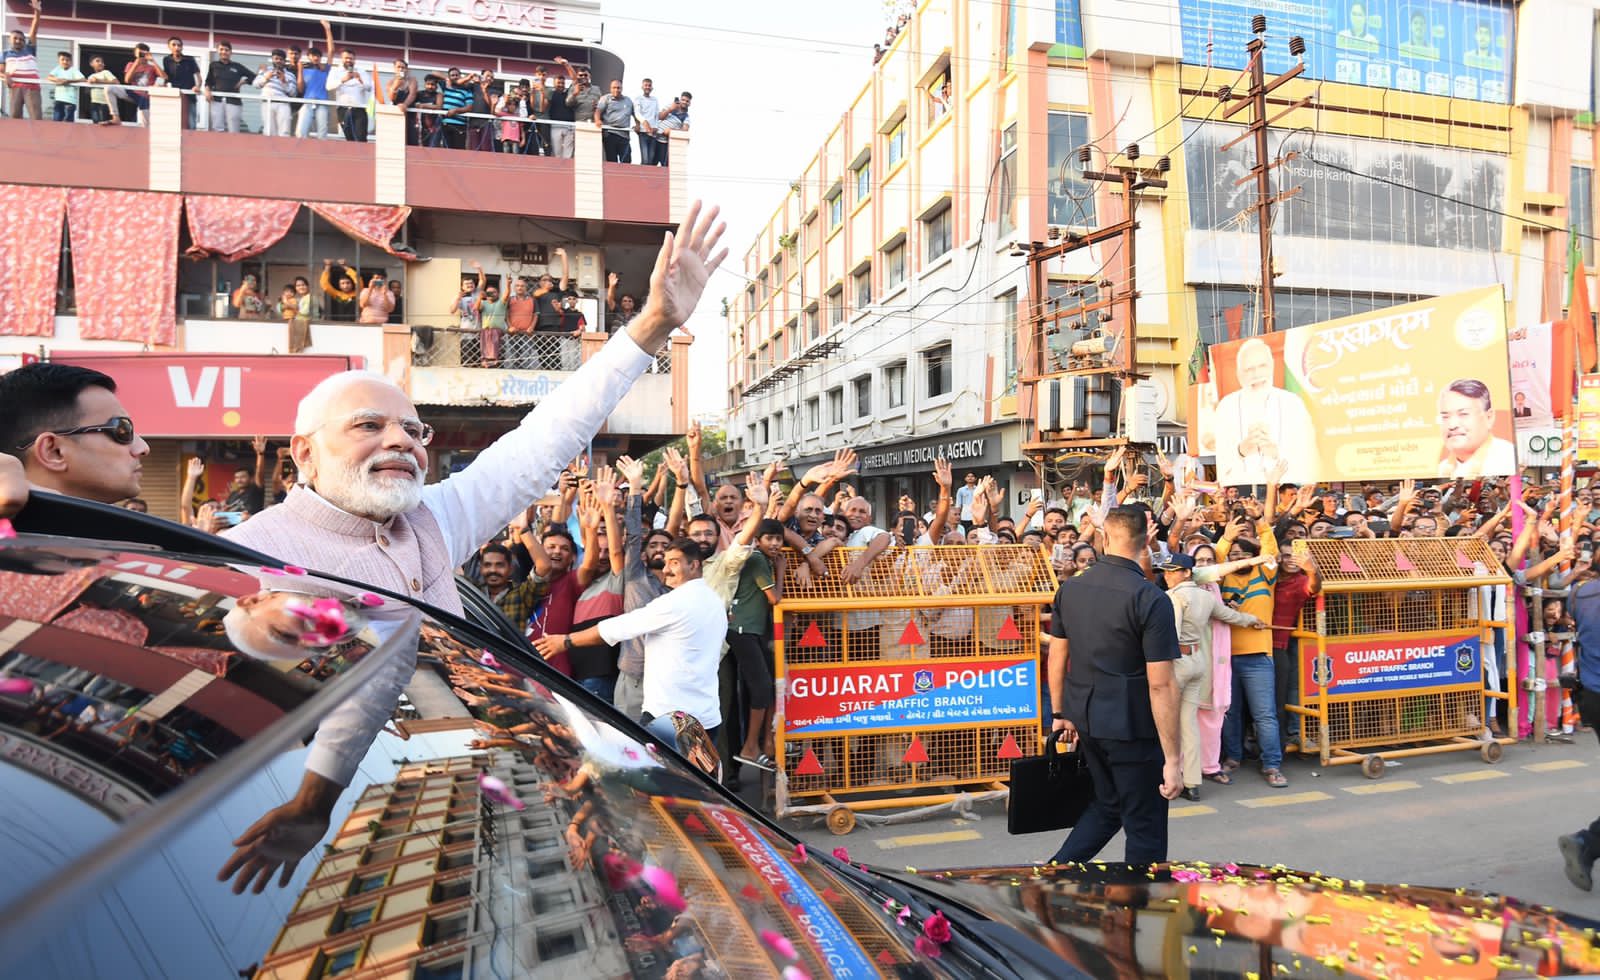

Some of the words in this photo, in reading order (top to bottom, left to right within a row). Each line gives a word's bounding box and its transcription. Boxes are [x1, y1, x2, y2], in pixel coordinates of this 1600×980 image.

[307, 0, 440, 16] ERY
[471, 0, 558, 30] CAKE
[864, 450, 903, 469] SHREENATHJI
[904, 447, 936, 466] MEDICAL
[938, 444, 946, 460] &
[947, 439, 985, 460] AGENCY
[1529, 435, 1577, 460] op
[1345, 649, 1403, 663] GUJARAT
[1405, 646, 1445, 659] POLICE
[1358, 665, 1379, 675] STATE
[1379, 663, 1408, 673] TRAFFIC
[1408, 662, 1434, 671] BRANCH
[791, 673, 903, 698] GUJARAT
[945, 667, 1029, 690] POLICE
[840, 700, 876, 712] STATE
[881, 698, 930, 710] TRAFFIC
[934, 695, 983, 707] BRANCH
[853, 714, 869, 725] બાજુ
